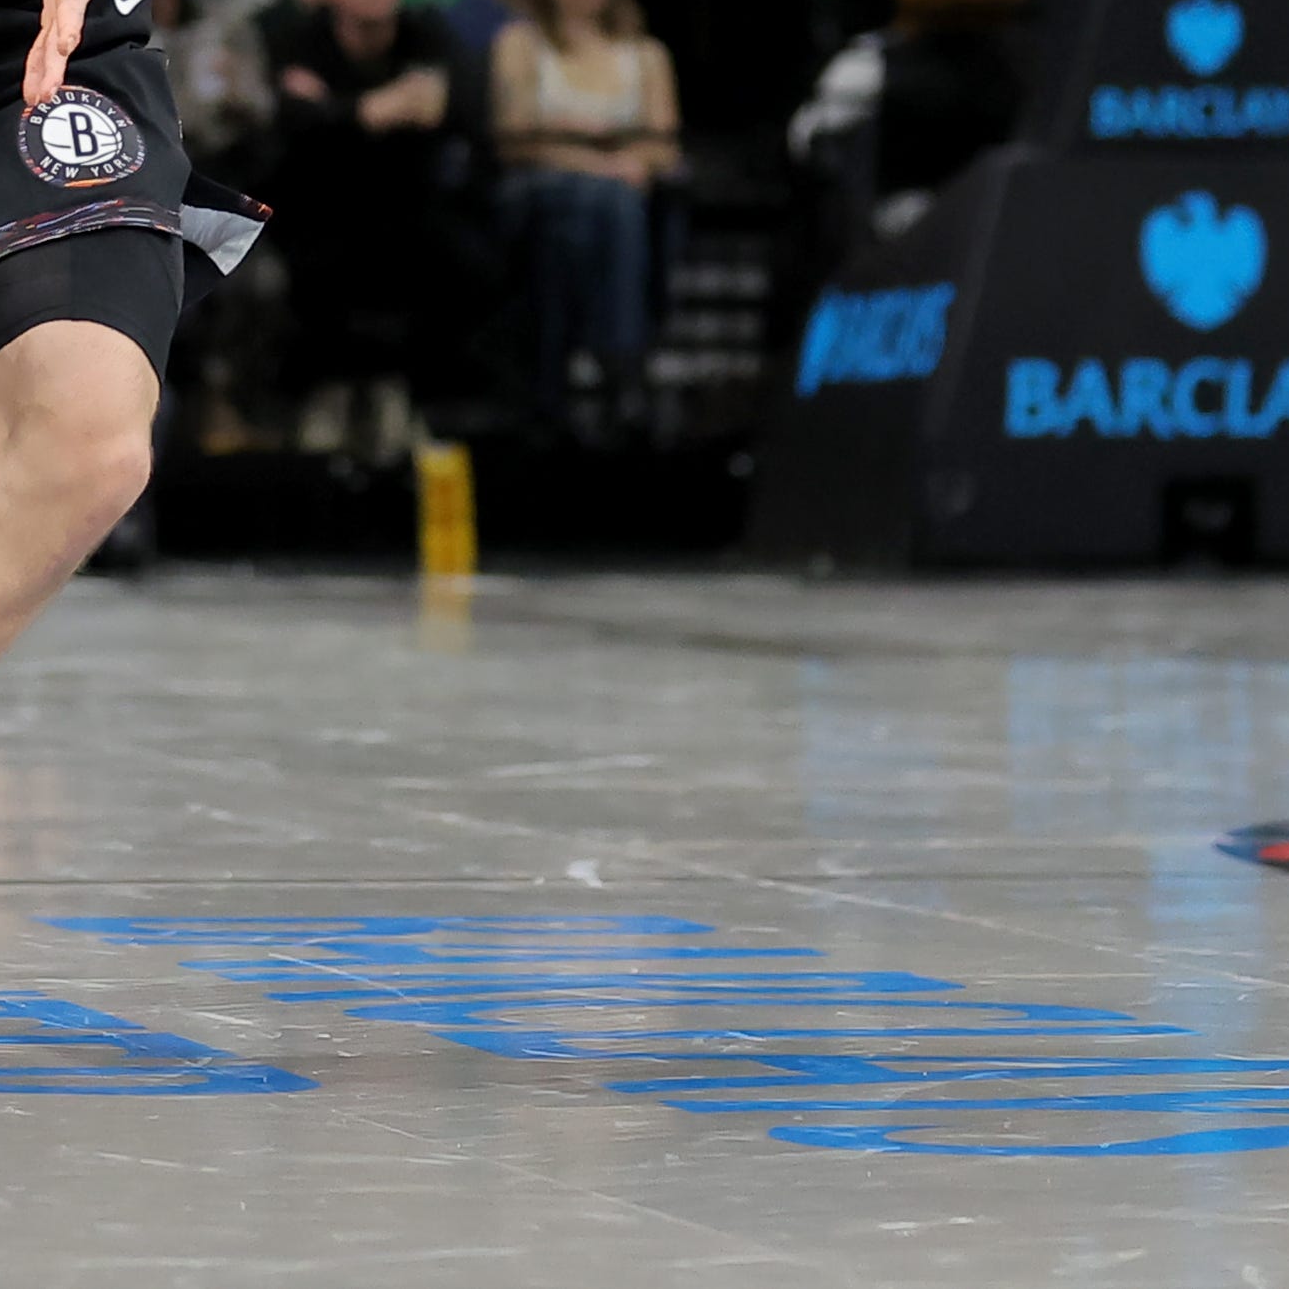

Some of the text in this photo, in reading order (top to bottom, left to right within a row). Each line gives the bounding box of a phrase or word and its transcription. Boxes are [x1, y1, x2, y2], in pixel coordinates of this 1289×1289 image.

[67, 111, 99, 158] B
[40, 153, 133, 179] NEW YORK
